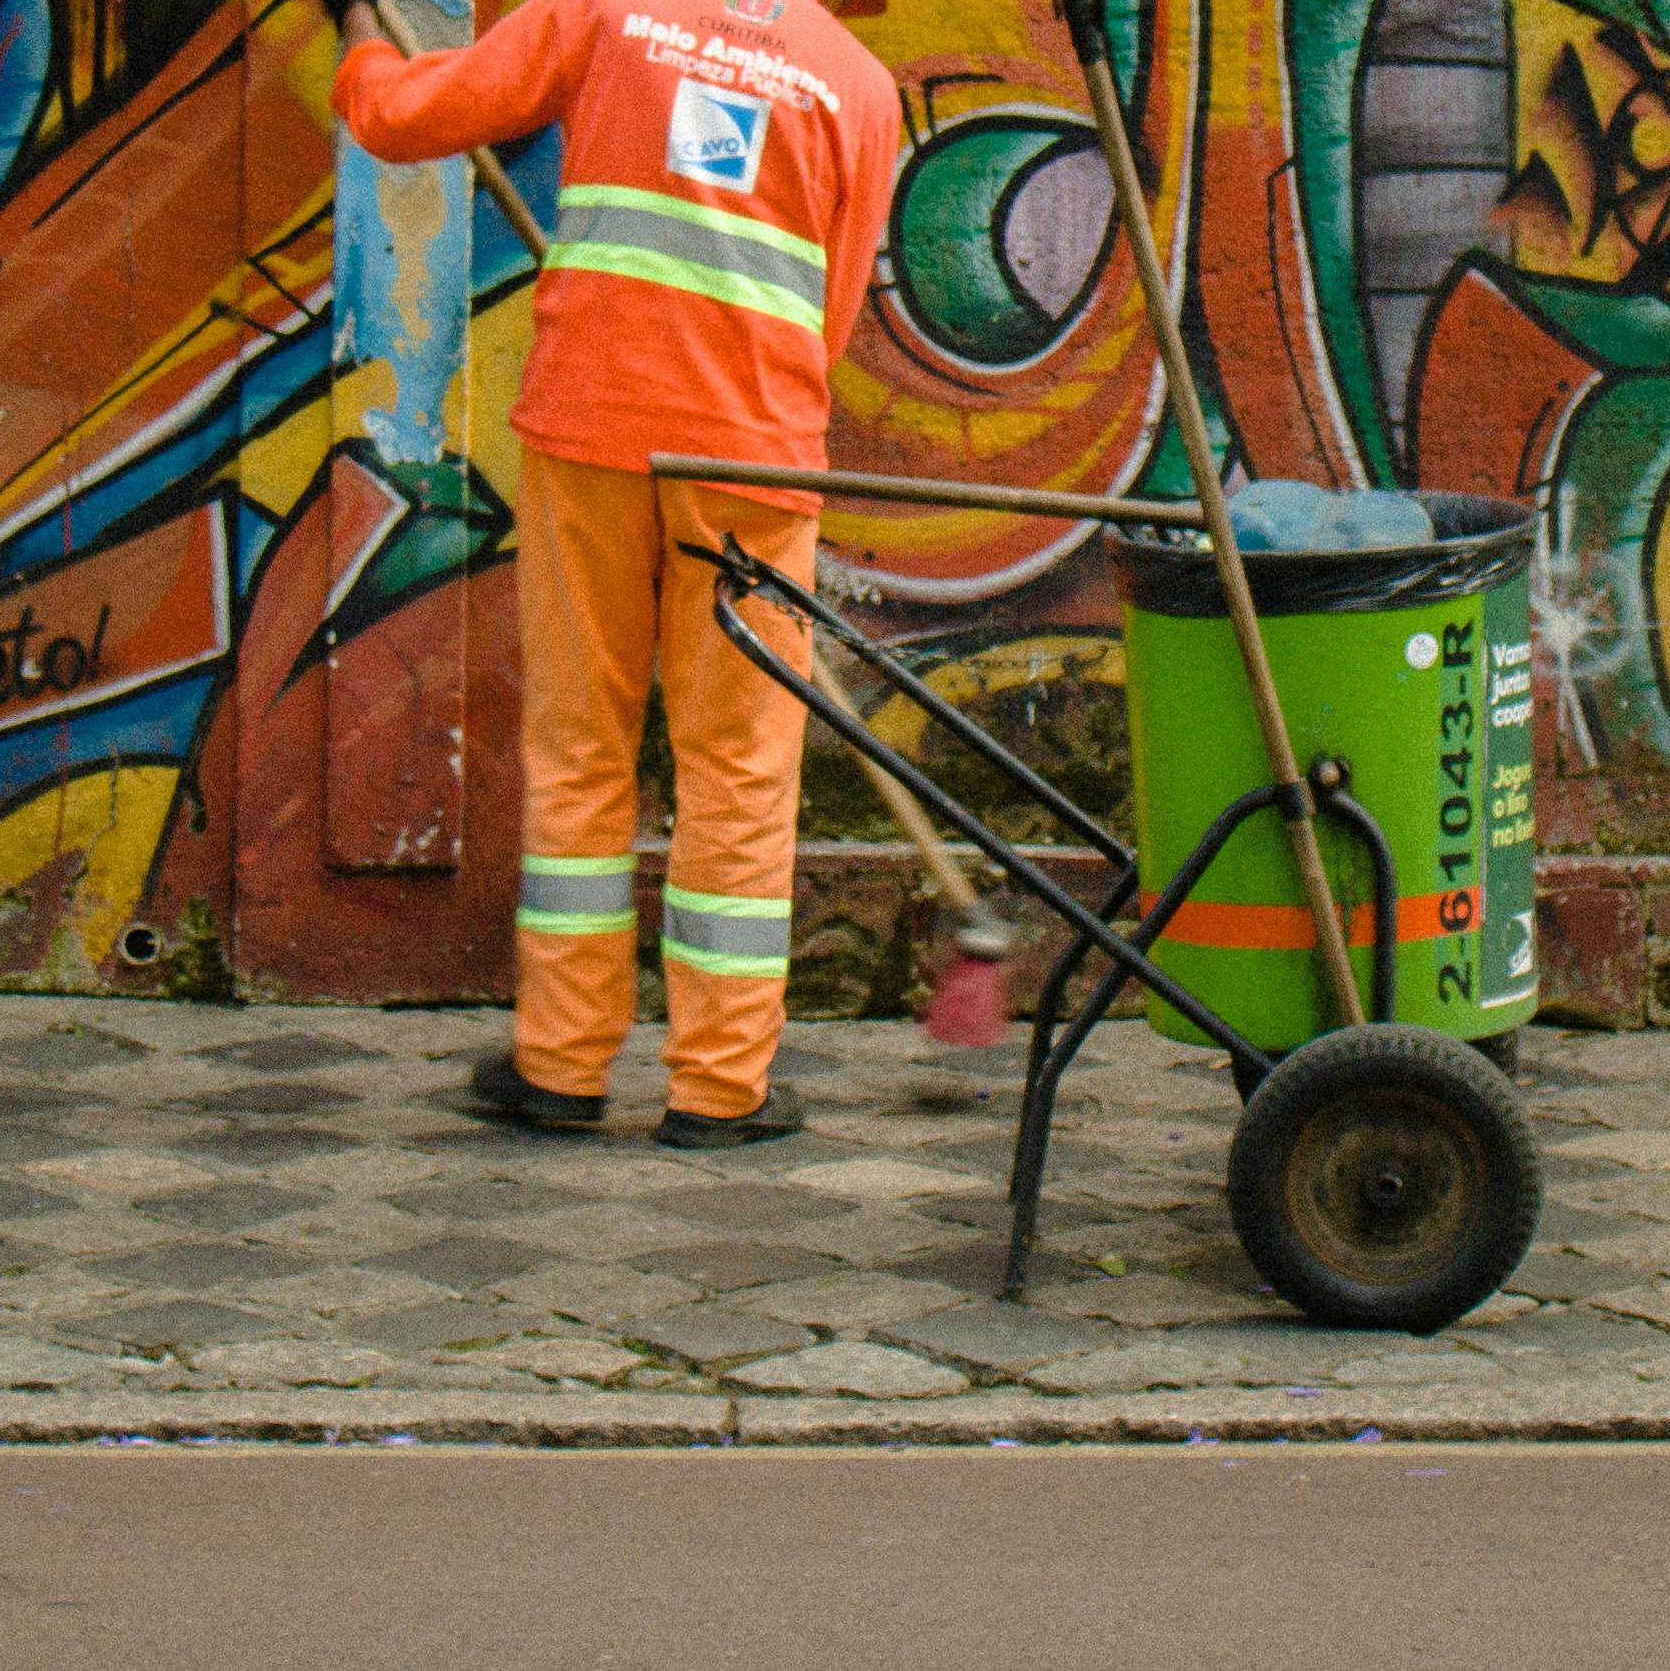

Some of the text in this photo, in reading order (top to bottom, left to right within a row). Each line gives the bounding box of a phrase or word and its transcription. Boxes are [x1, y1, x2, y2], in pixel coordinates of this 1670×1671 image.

[623, 13, 697, 51] Meio
[698, 16, 786, 51] CURITIBA
[646, 40, 735, 84] Limpeza
[683, 137, 740, 158] CAVO
[1438, 620, 1474, 1004] 2-61043-R
